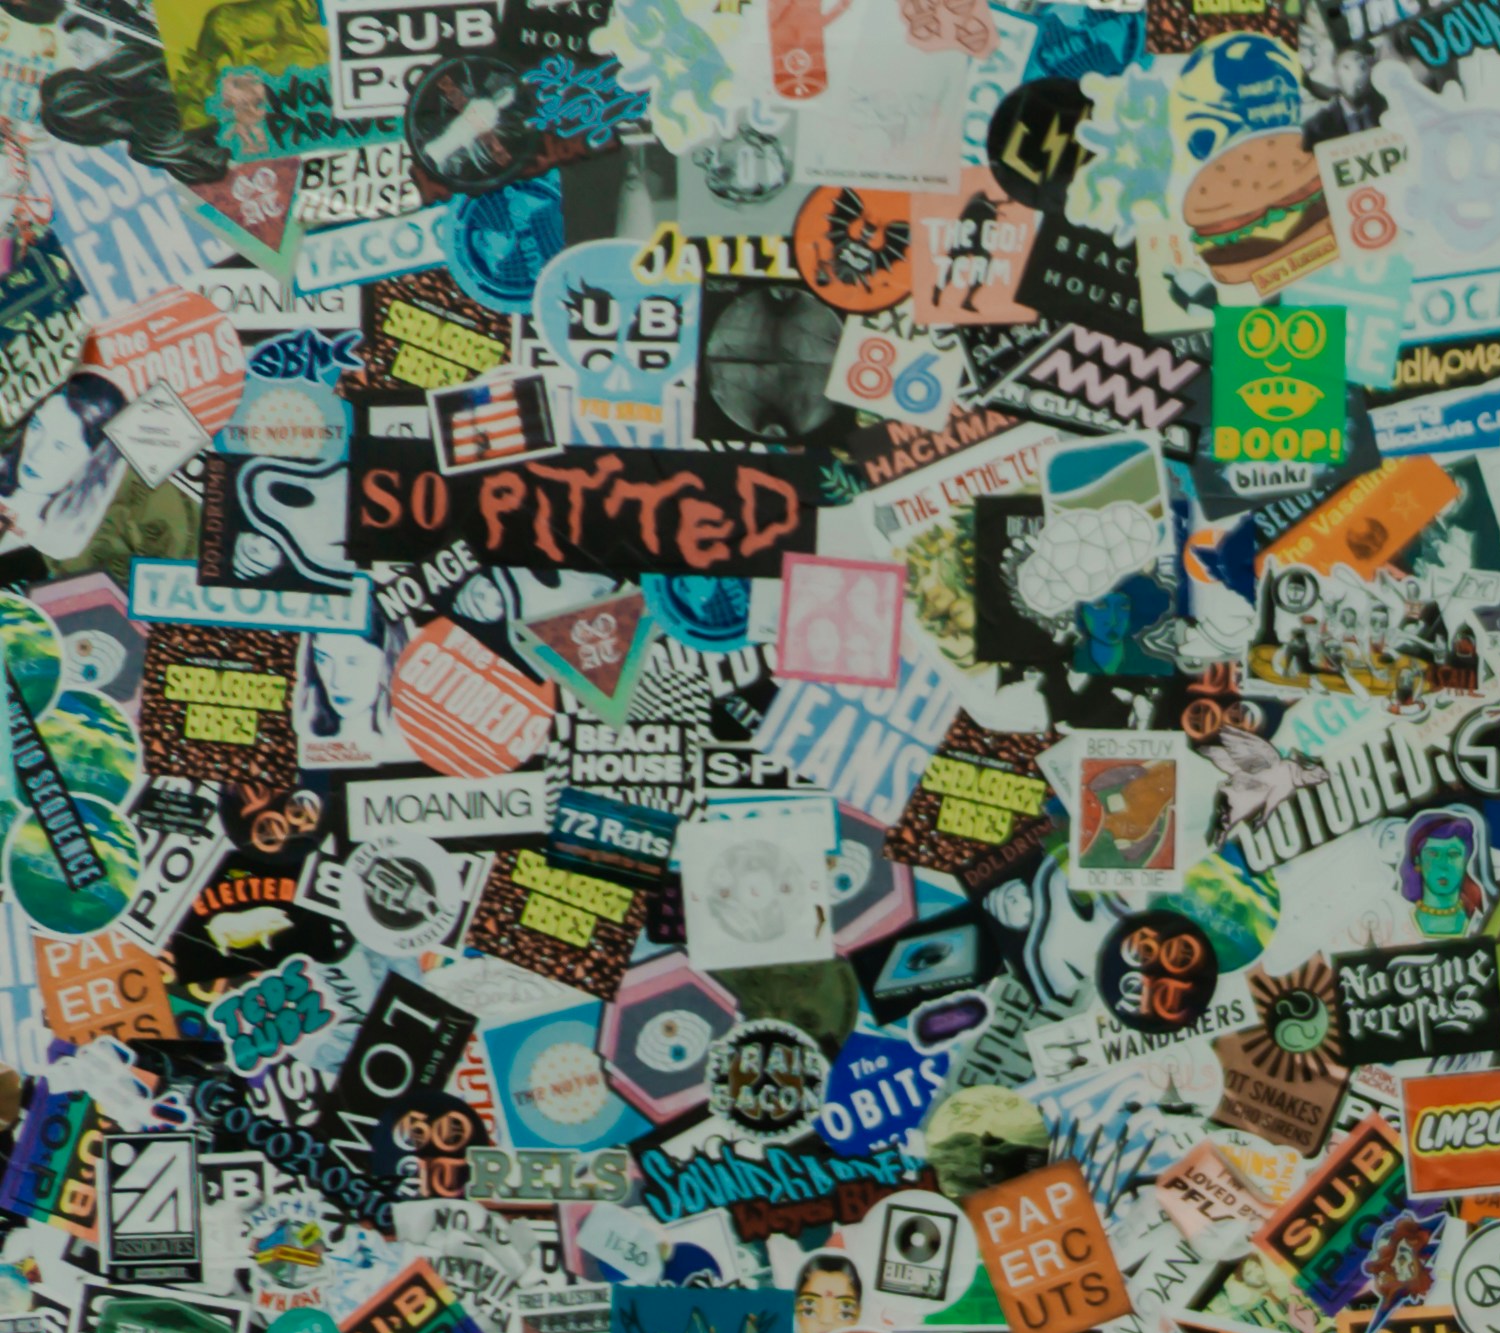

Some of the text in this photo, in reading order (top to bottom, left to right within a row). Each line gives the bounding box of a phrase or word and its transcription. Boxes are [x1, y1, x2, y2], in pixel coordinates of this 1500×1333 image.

[1214, 426, 1340, 461] BOOP!
[577, 724, 682, 751] BEACH
[573, 753, 682, 781] HOUSE
[364, 789, 532, 827] MOANING
[560, 808, 668, 860] 72 Rats
